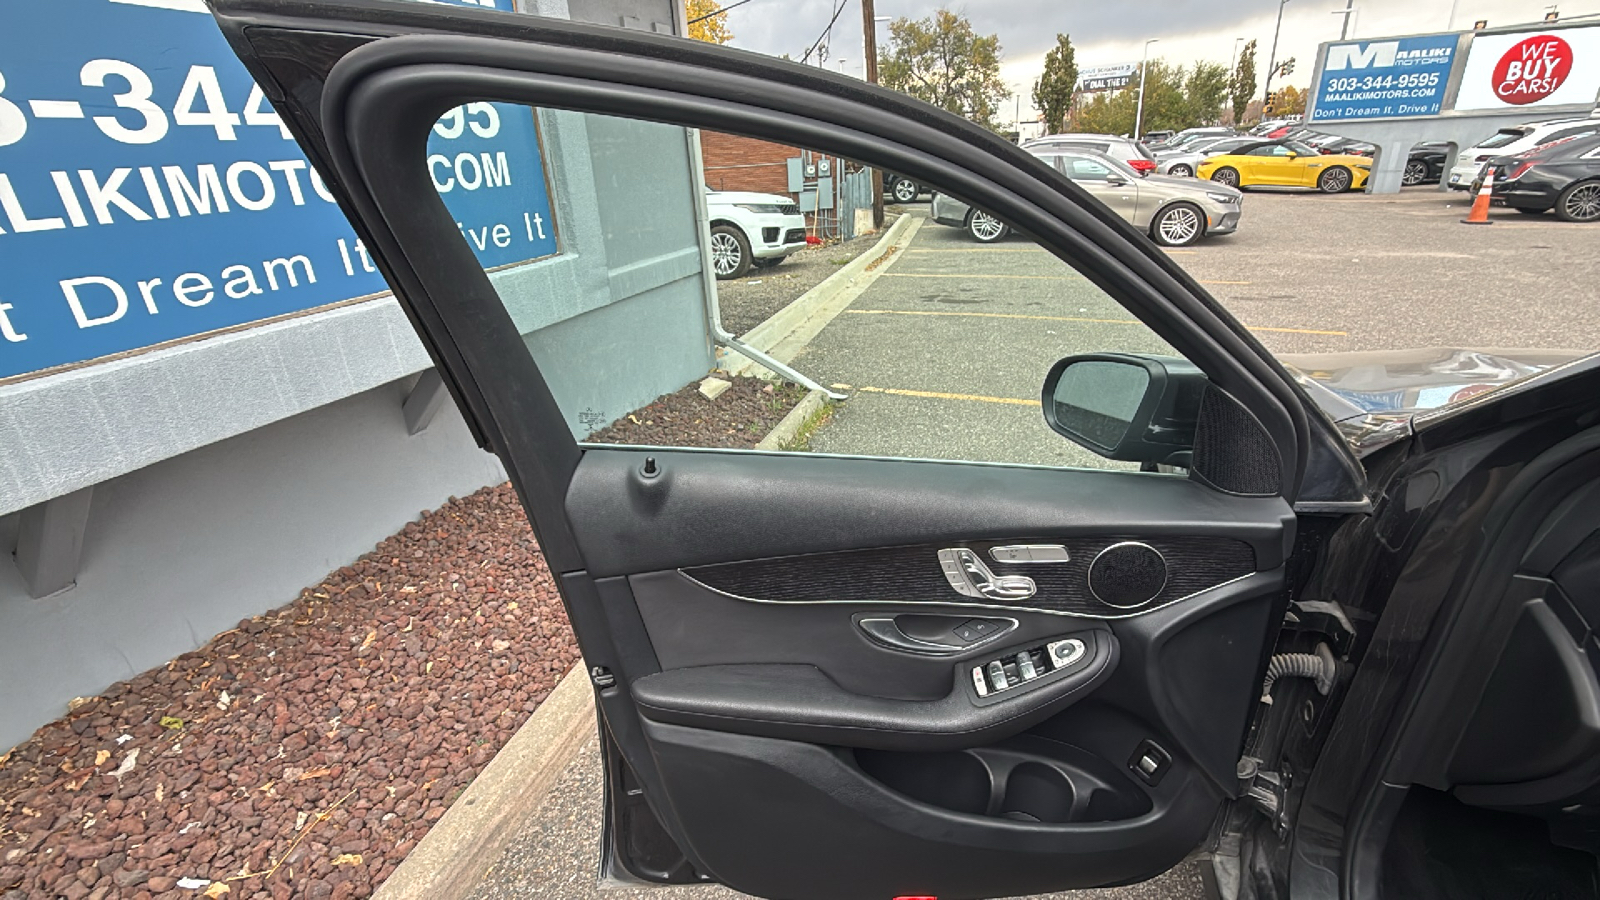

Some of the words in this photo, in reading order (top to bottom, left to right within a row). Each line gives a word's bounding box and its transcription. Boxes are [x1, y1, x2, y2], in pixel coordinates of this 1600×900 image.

[1522, 41, 1559, 61] WE
[1394, 56, 1450, 66] MOTORS
[1505, 57, 1562, 81] BUY
[1090, 79, 1106, 89] DIAL
[1106, 78, 1121, 88] THE
[1327, 72, 1440, 92] 303-344-9595
[1497, 77, 1558, 95] CARS!
[1324, 88, 1436, 102] MAALIKIMOTORS.COM
[1314, 108, 1342, 118] Don't
[1345, 106, 1380, 116] Dream
[1398, 104, 1428, 114] Drive
[1431, 103, 1440, 113] It
[59, 254, 317, 329] Dream
[523, 212, 546, 242] It
